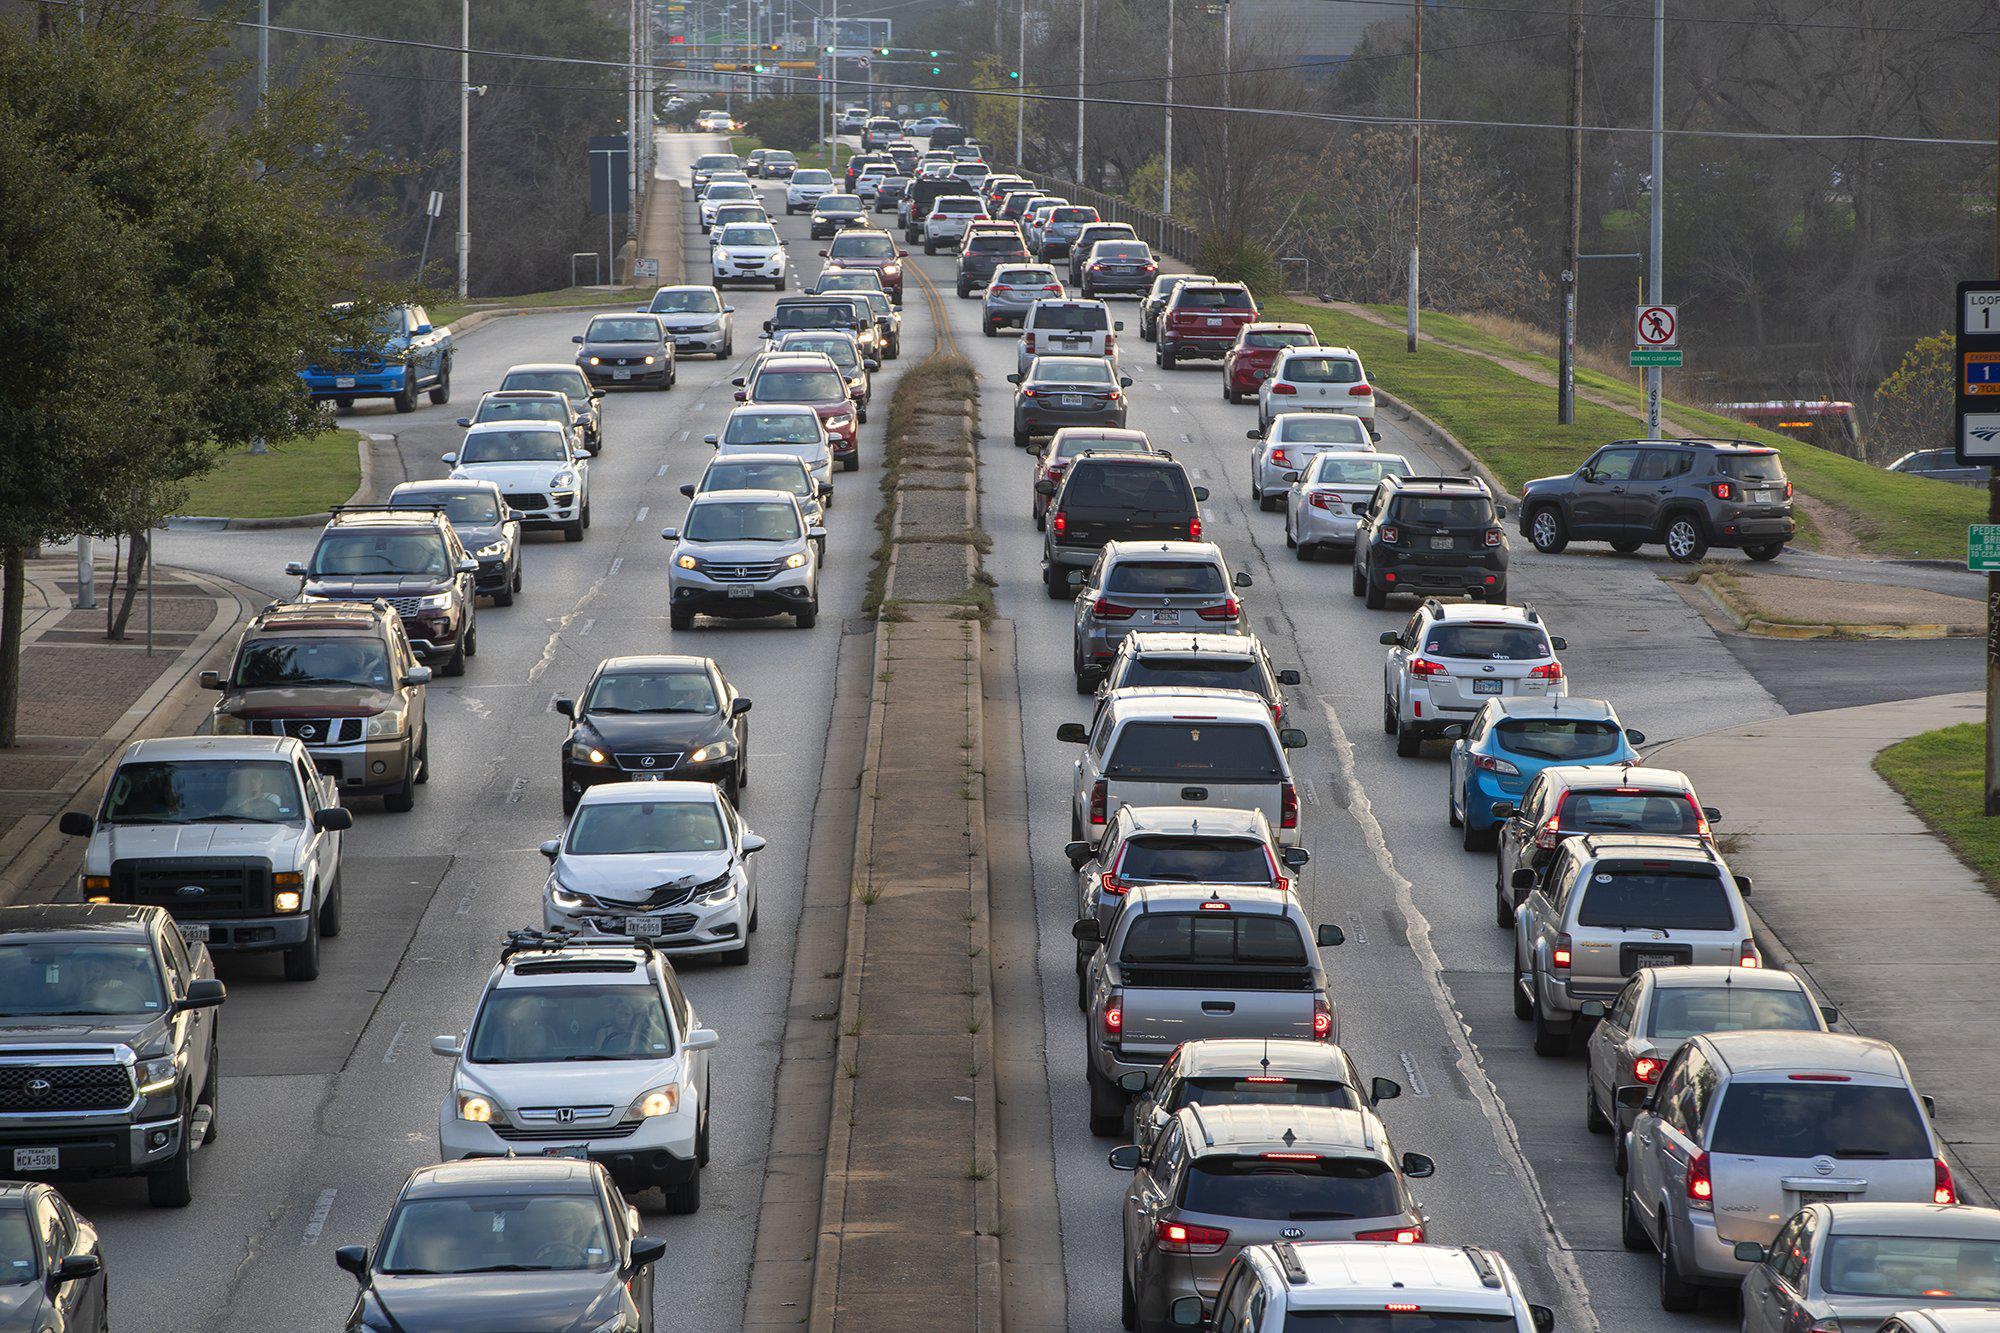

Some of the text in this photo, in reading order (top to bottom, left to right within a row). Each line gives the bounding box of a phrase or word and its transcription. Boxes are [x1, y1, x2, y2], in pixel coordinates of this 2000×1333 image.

[1982, 307, 1990, 329] 1
[1983, 366, 1990, 380] 1
[1980, 385, 2000, 393] TOL
[1983, 535, 2000, 544] BRI
[1284, 1229, 1302, 1237] KIA
